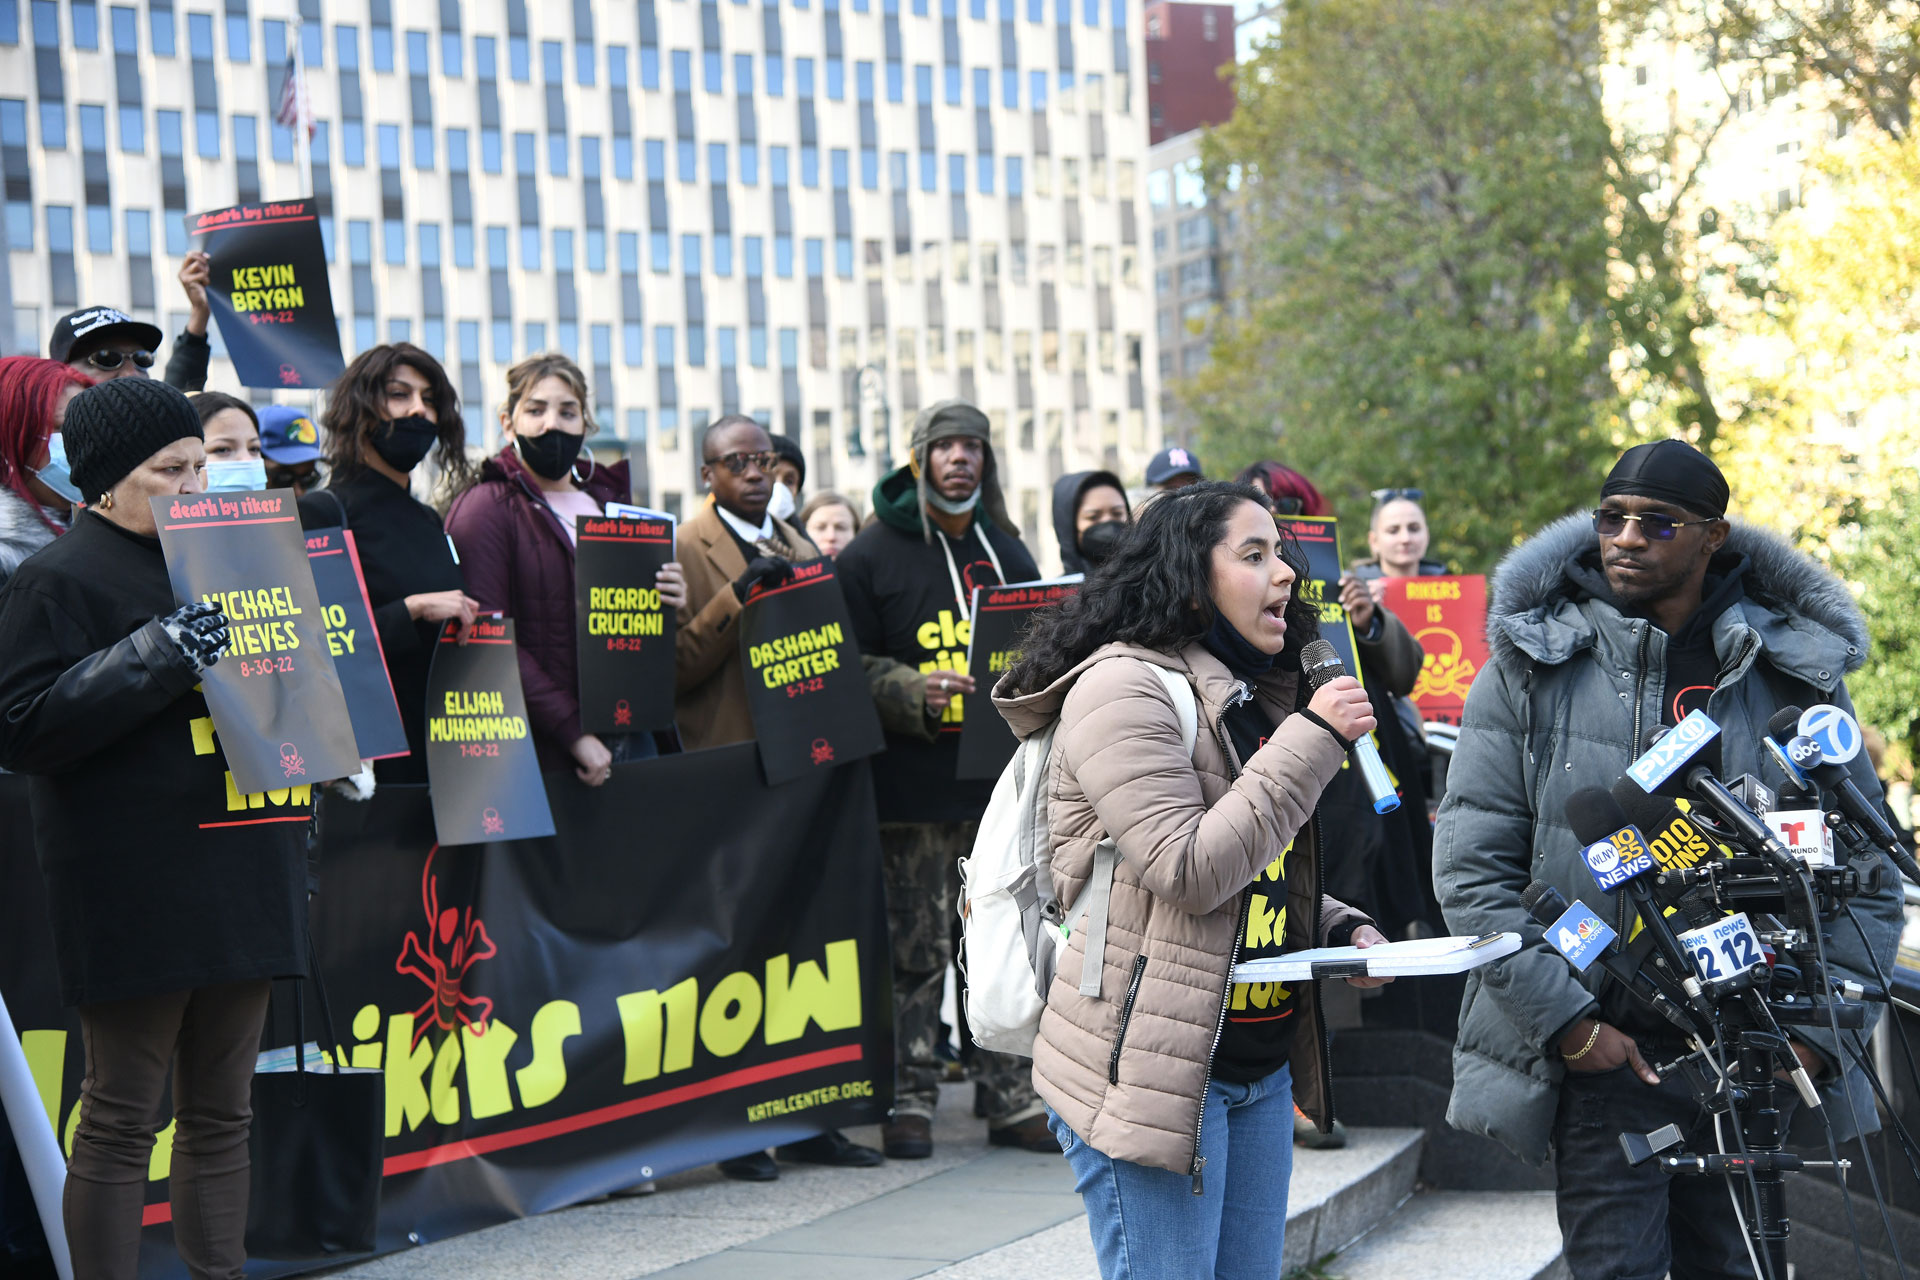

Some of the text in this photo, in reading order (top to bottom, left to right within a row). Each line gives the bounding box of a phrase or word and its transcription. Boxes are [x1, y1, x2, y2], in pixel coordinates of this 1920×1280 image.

[232, 264, 295, 290] KEVIN
[231, 286, 305, 312] BRYAN
[169, 496, 282, 519] death by rikers
[590, 587, 661, 611] RICARDO
[1406, 581, 1461, 600] RIKERS
[588, 612, 664, 636] CRUCIANI
[1426, 604, 1443, 623] IS
[749, 622, 844, 669] DASHAWN
[240, 656, 295, 677] 8-30-22
[762, 648, 840, 689] CARTER
[786, 677, 824, 698] 5-7-22
[444, 691, 504, 715] ELIJAH
[429, 716, 527, 742] MUHAMMAD
[460, 743, 500, 757] 7-10-22
[1633, 732, 1688, 782] PIX
[1792, 741, 1820, 762] abc
[1610, 828, 1636, 848] 10
[1649, 818, 1694, 863] 010
[1589, 847, 1615, 866] WLNY
[1618, 840, 1644, 864] 55
[1790, 847, 1818, 855] MUNDO
[1598, 855, 1652, 889] NEWS
[1558, 926, 1582, 953] 4
[1713, 918, 1746, 940] news
[1570, 924, 1606, 961] NEW YORK
[1720, 931, 1761, 971] 12
[322, 999, 583, 1138] ikers
[616, 939, 862, 1086] now
[747, 1080, 874, 1123] KATALCENTER.ORG
